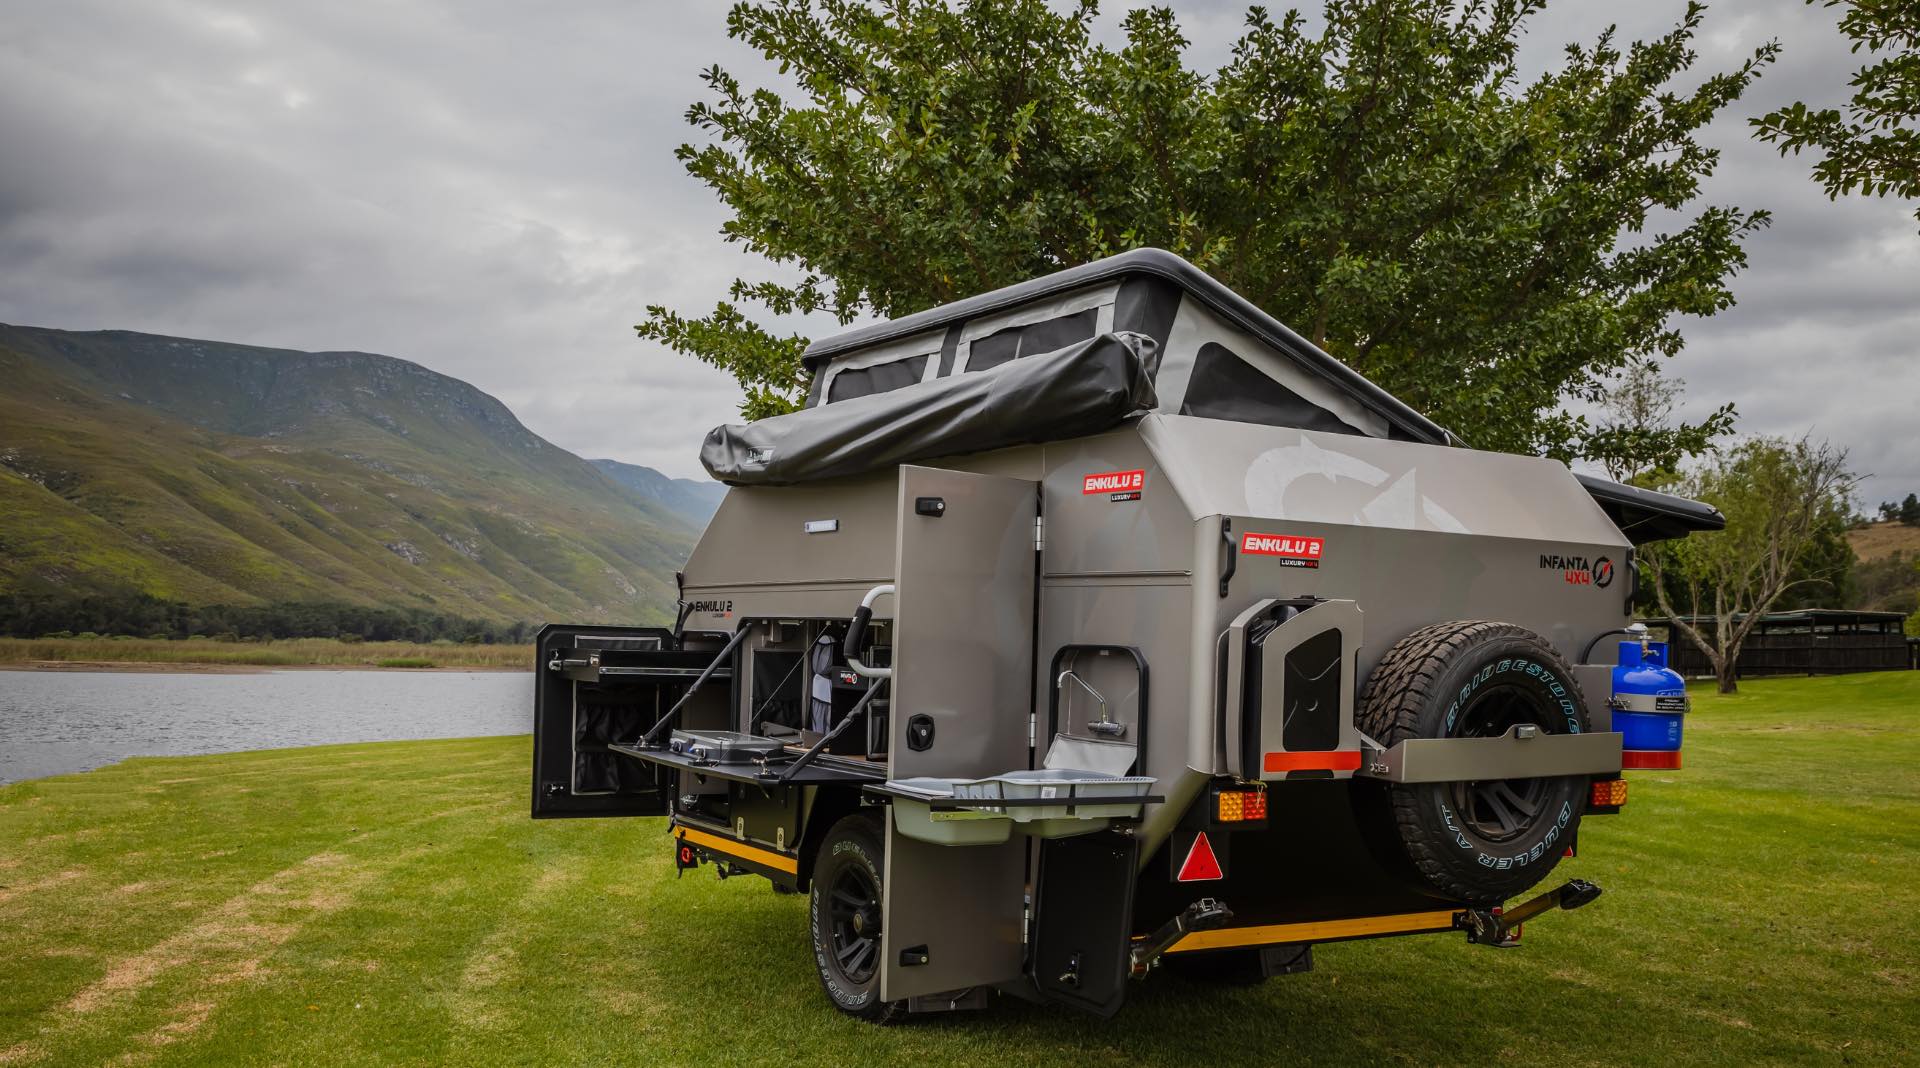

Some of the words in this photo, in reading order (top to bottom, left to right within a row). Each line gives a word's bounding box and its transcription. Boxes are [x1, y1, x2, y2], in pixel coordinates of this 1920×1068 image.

[1085, 475, 1131, 491] ENKULU
[1132, 473, 1142, 487] 2
[1244, 537, 1306, 554] ENKULU
[1308, 541, 1321, 555] 2
[1540, 554, 1590, 571] INFANTA
[1565, 570, 1590, 585] 4X4
[695, 600, 726, 612] ENKULU
[726, 600, 733, 612] 2
[1446, 659, 1581, 734] BRIDGESTONE
[1441, 804, 1474, 849] A/T
[1478, 801, 1572, 870] DUELER
[812, 886, 869, 1005] BRIDGESTONE
